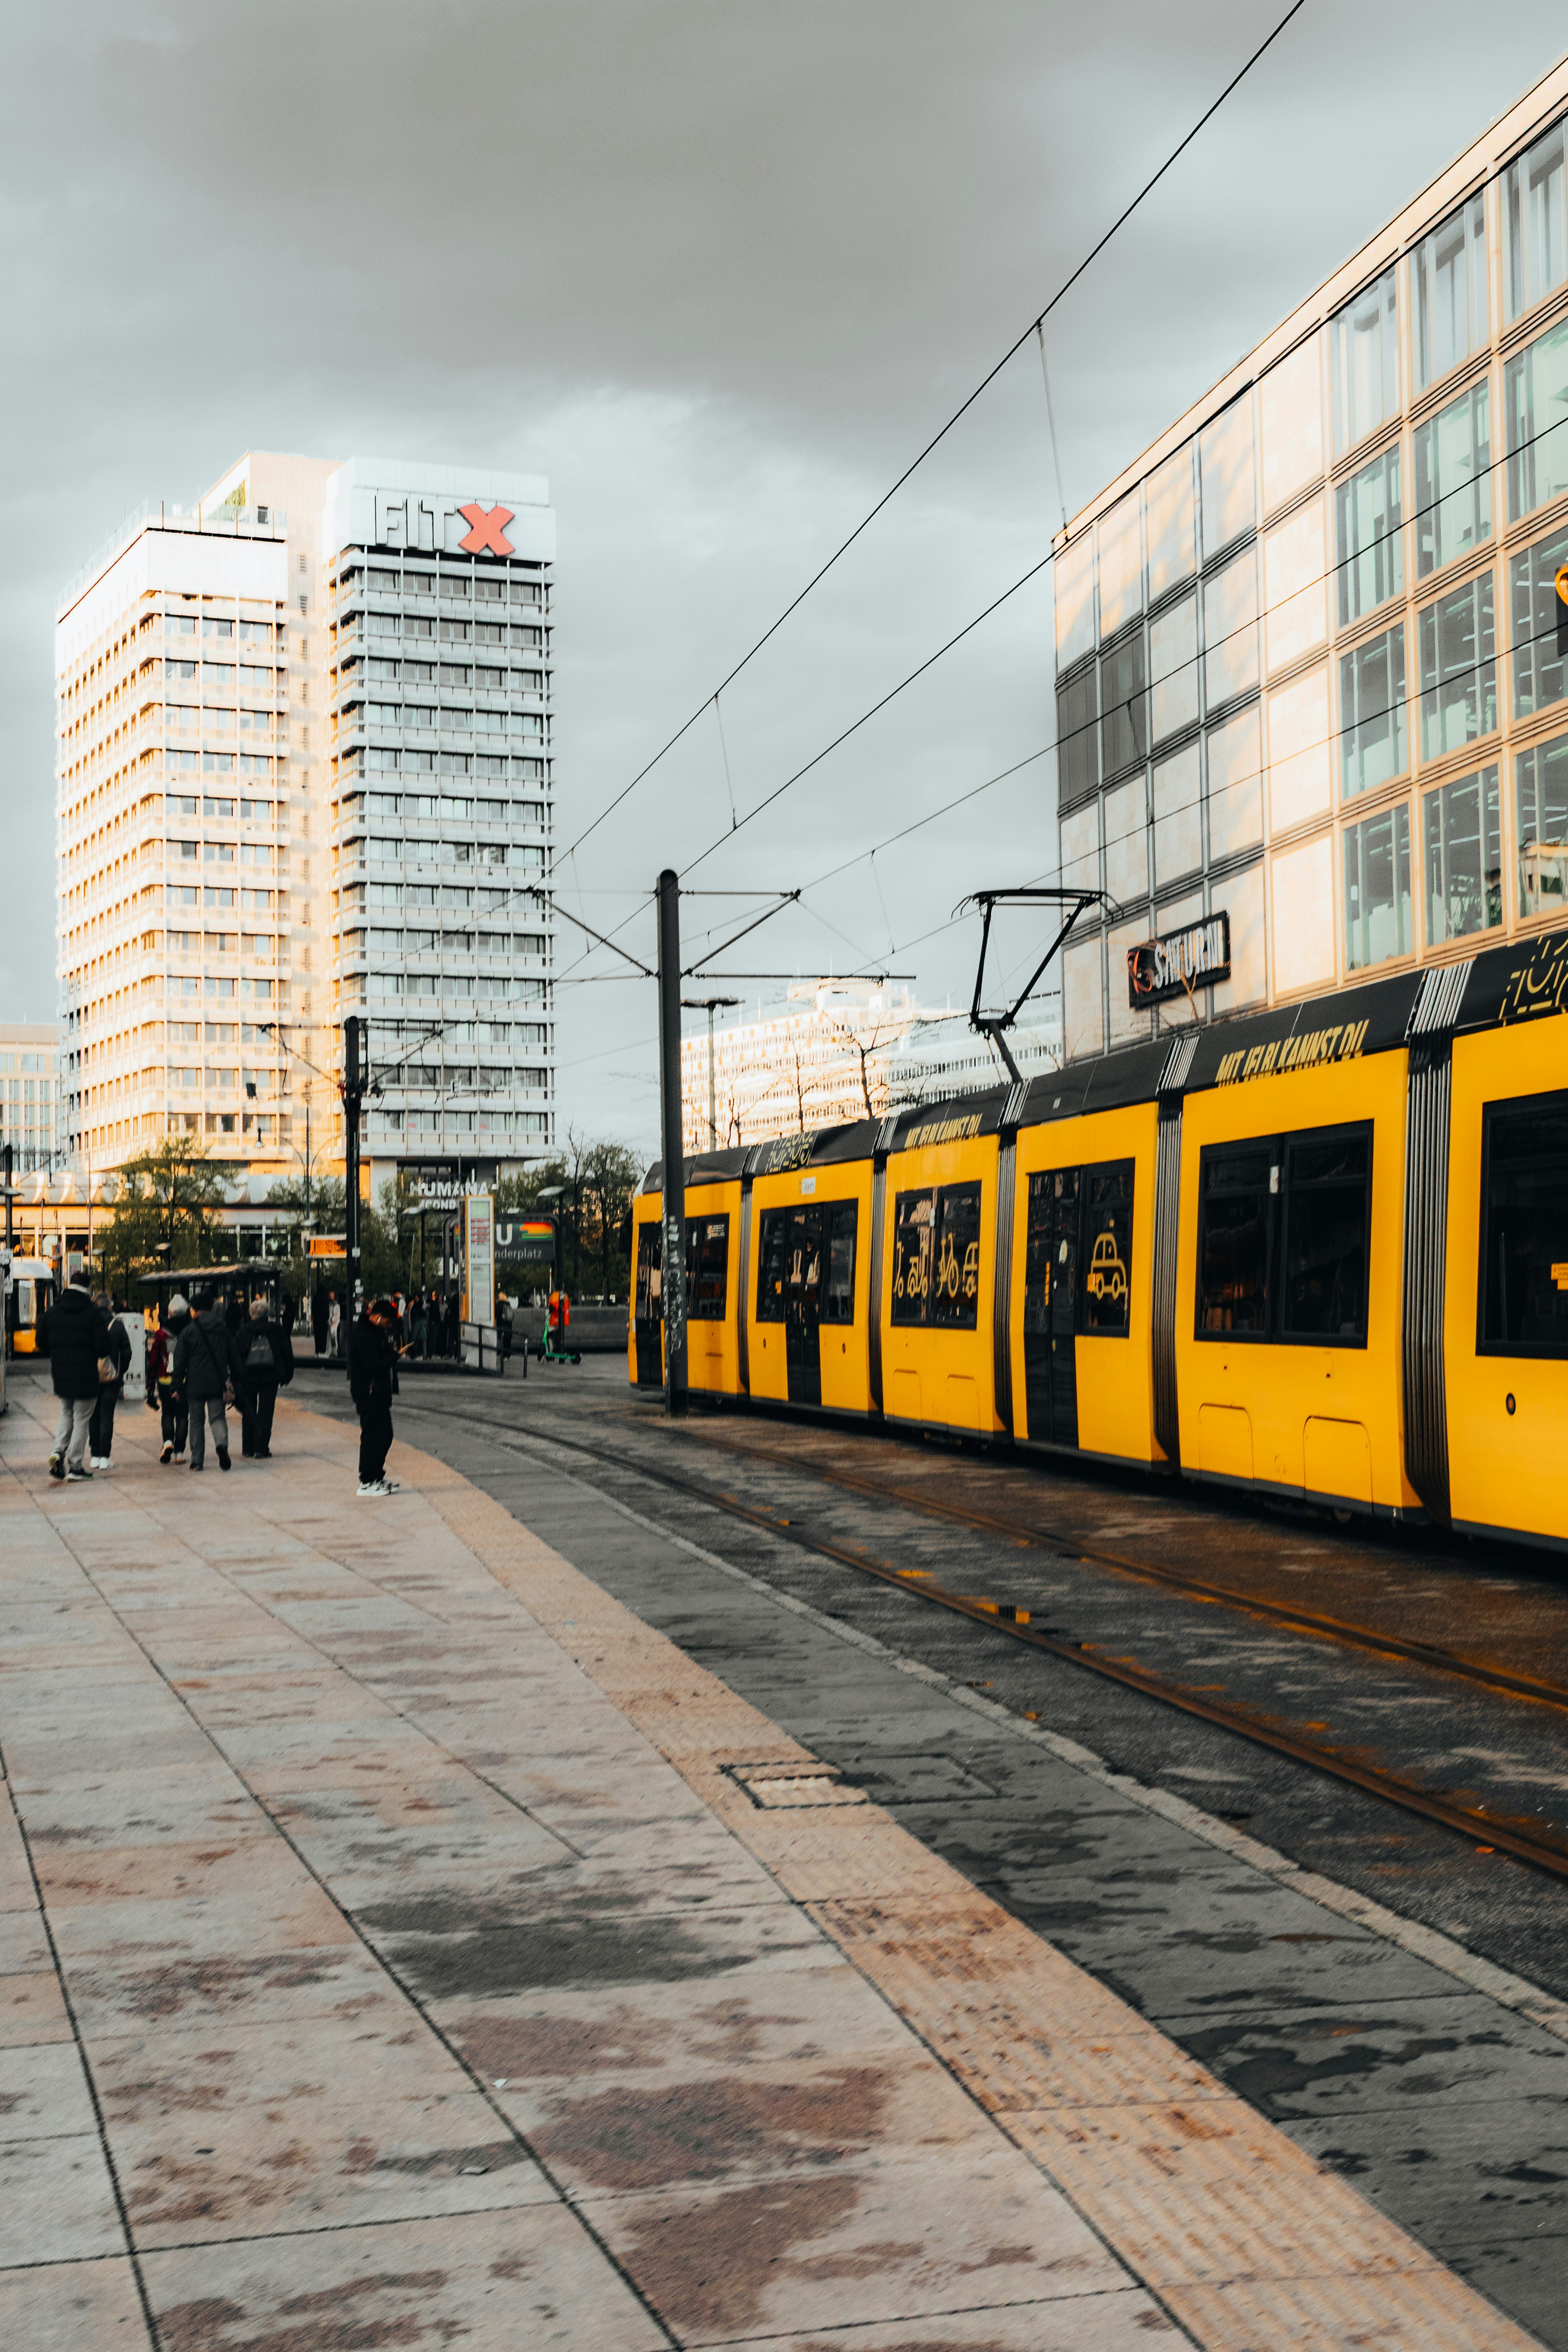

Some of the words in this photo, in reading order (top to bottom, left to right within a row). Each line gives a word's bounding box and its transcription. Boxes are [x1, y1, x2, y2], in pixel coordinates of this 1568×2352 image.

[375, 495, 516, 556] FITX
[1155, 920, 1223, 988] SATURN
[1215, 1050, 1246, 1088] MIT
[1277, 1025, 1343, 1074] KANNST
[1338, 1019, 1370, 1061] DU
[410, 1181, 488, 1196] HUMANA
[495, 1247, 542, 1261] nderplatz
[496, 1223, 512, 1246] U
